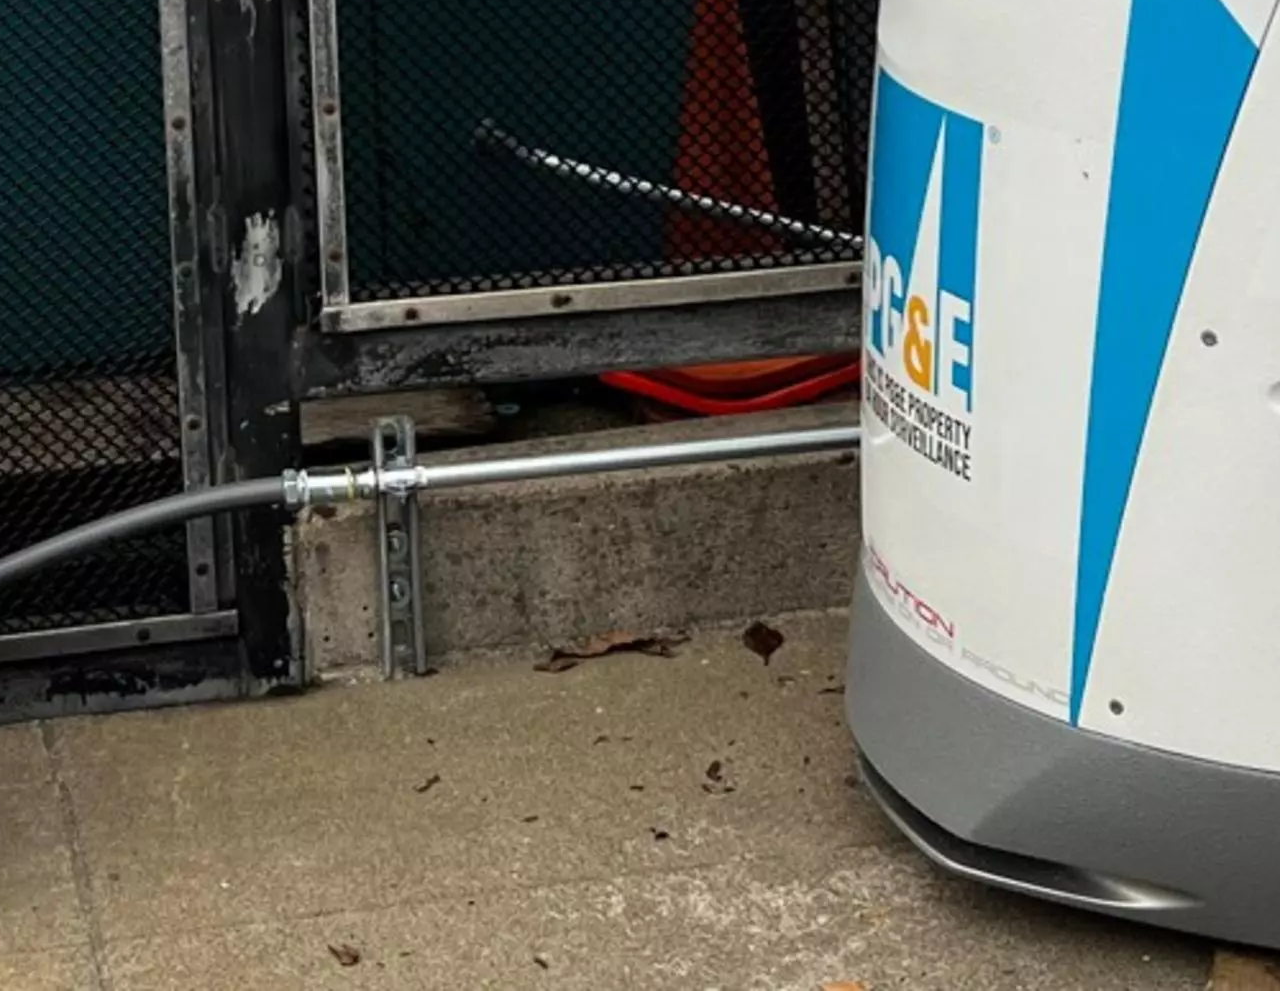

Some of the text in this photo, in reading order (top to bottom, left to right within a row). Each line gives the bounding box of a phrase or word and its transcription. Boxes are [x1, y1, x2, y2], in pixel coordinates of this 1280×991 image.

[864, 234, 972, 412] PG&E
[888, 405, 972, 483] SURVEILLANCE
[906, 391, 972, 450] PROPERTY
